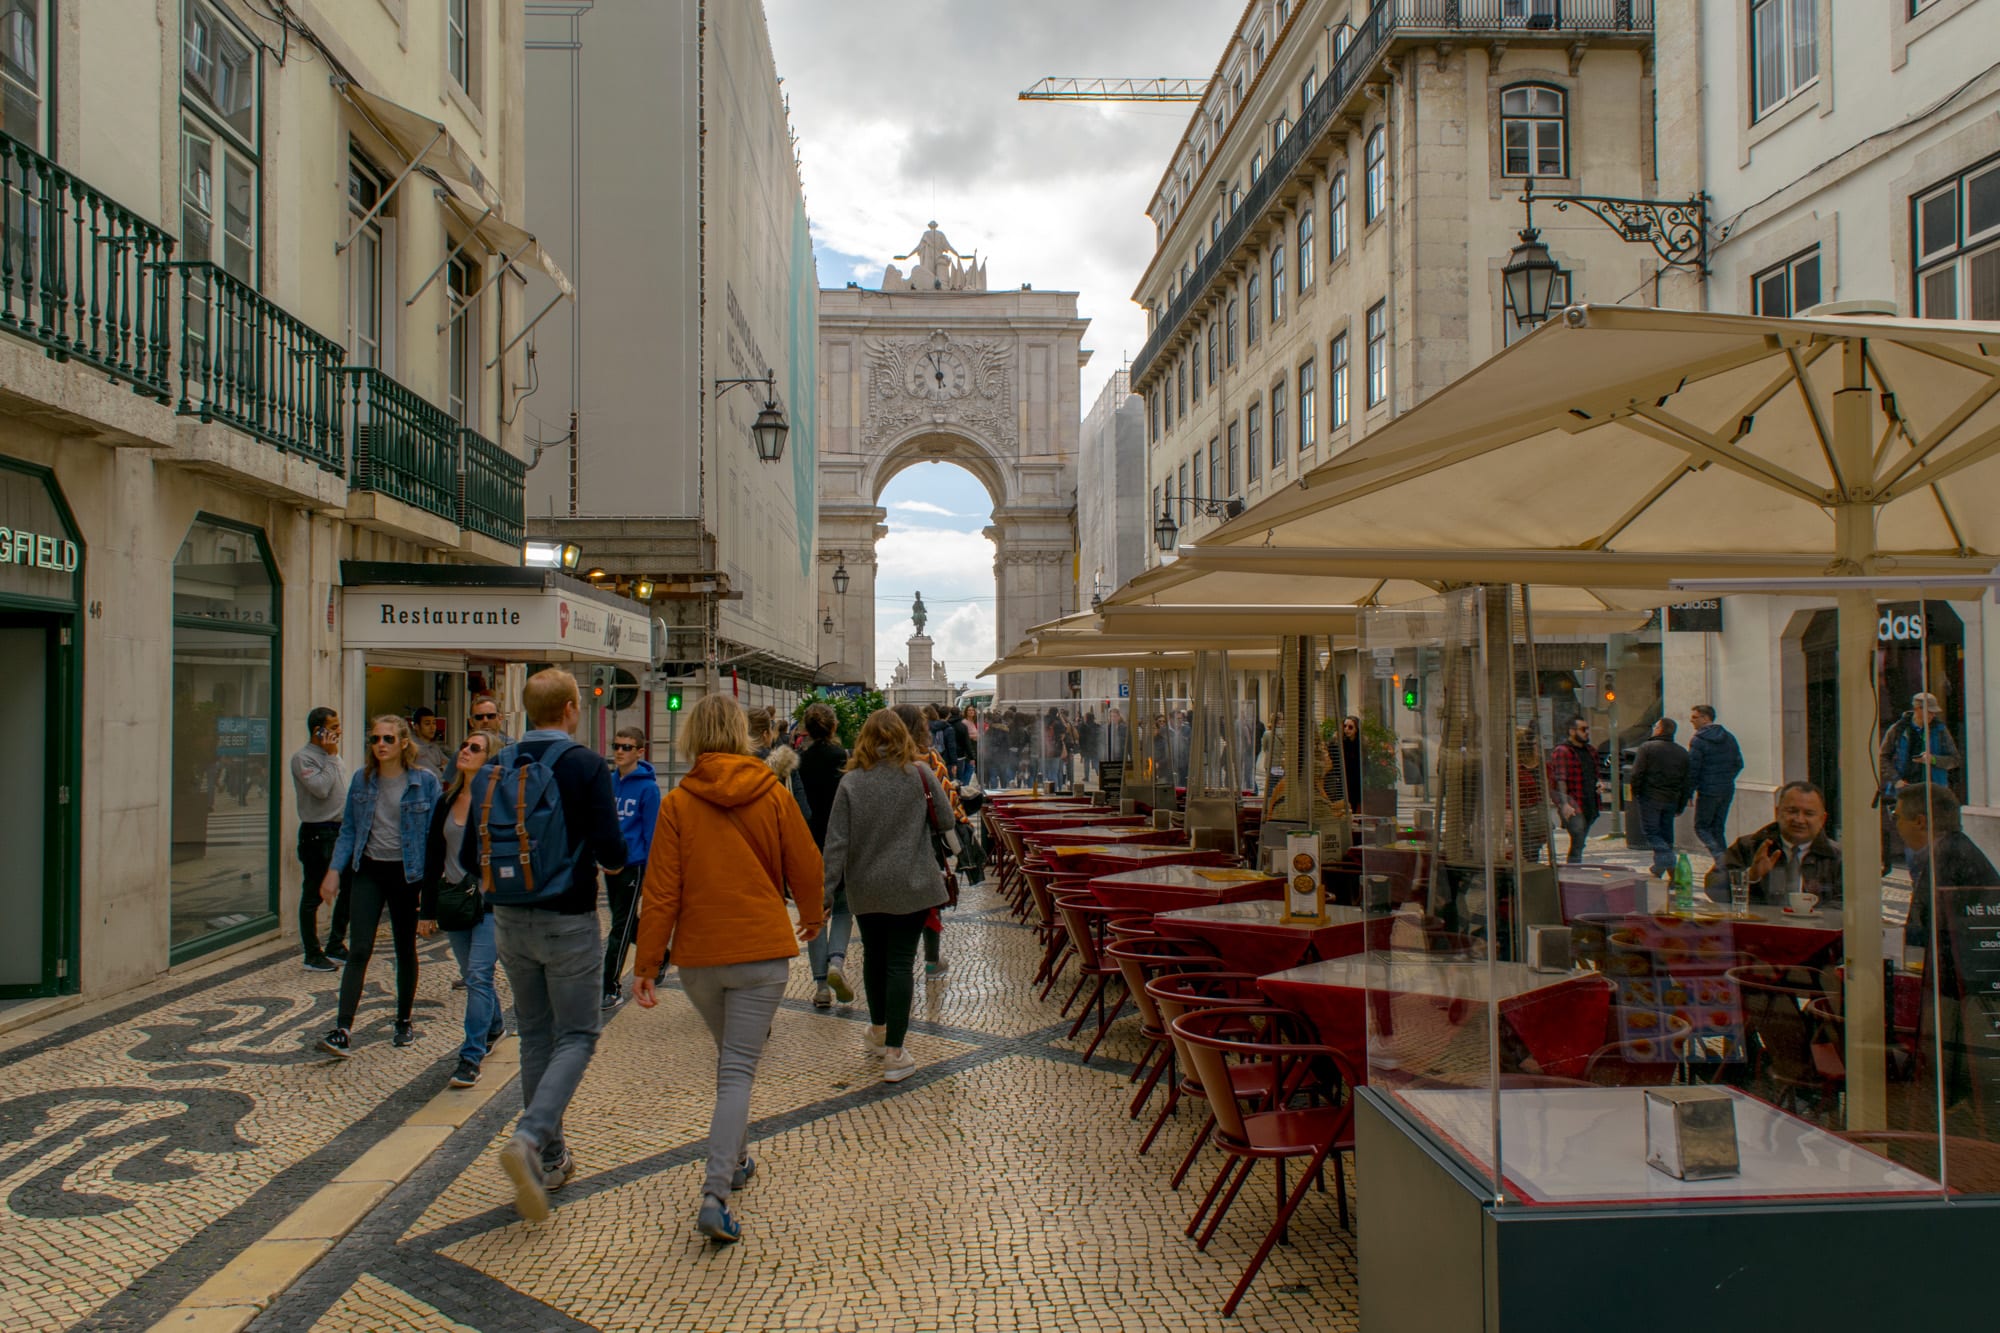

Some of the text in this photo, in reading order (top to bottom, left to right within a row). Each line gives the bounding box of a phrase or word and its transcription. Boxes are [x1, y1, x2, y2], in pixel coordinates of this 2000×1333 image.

[0, 526, 79, 573] GFIELD
[89, 600, 103, 619] 46
[381, 604, 520, 625] Restaurante
